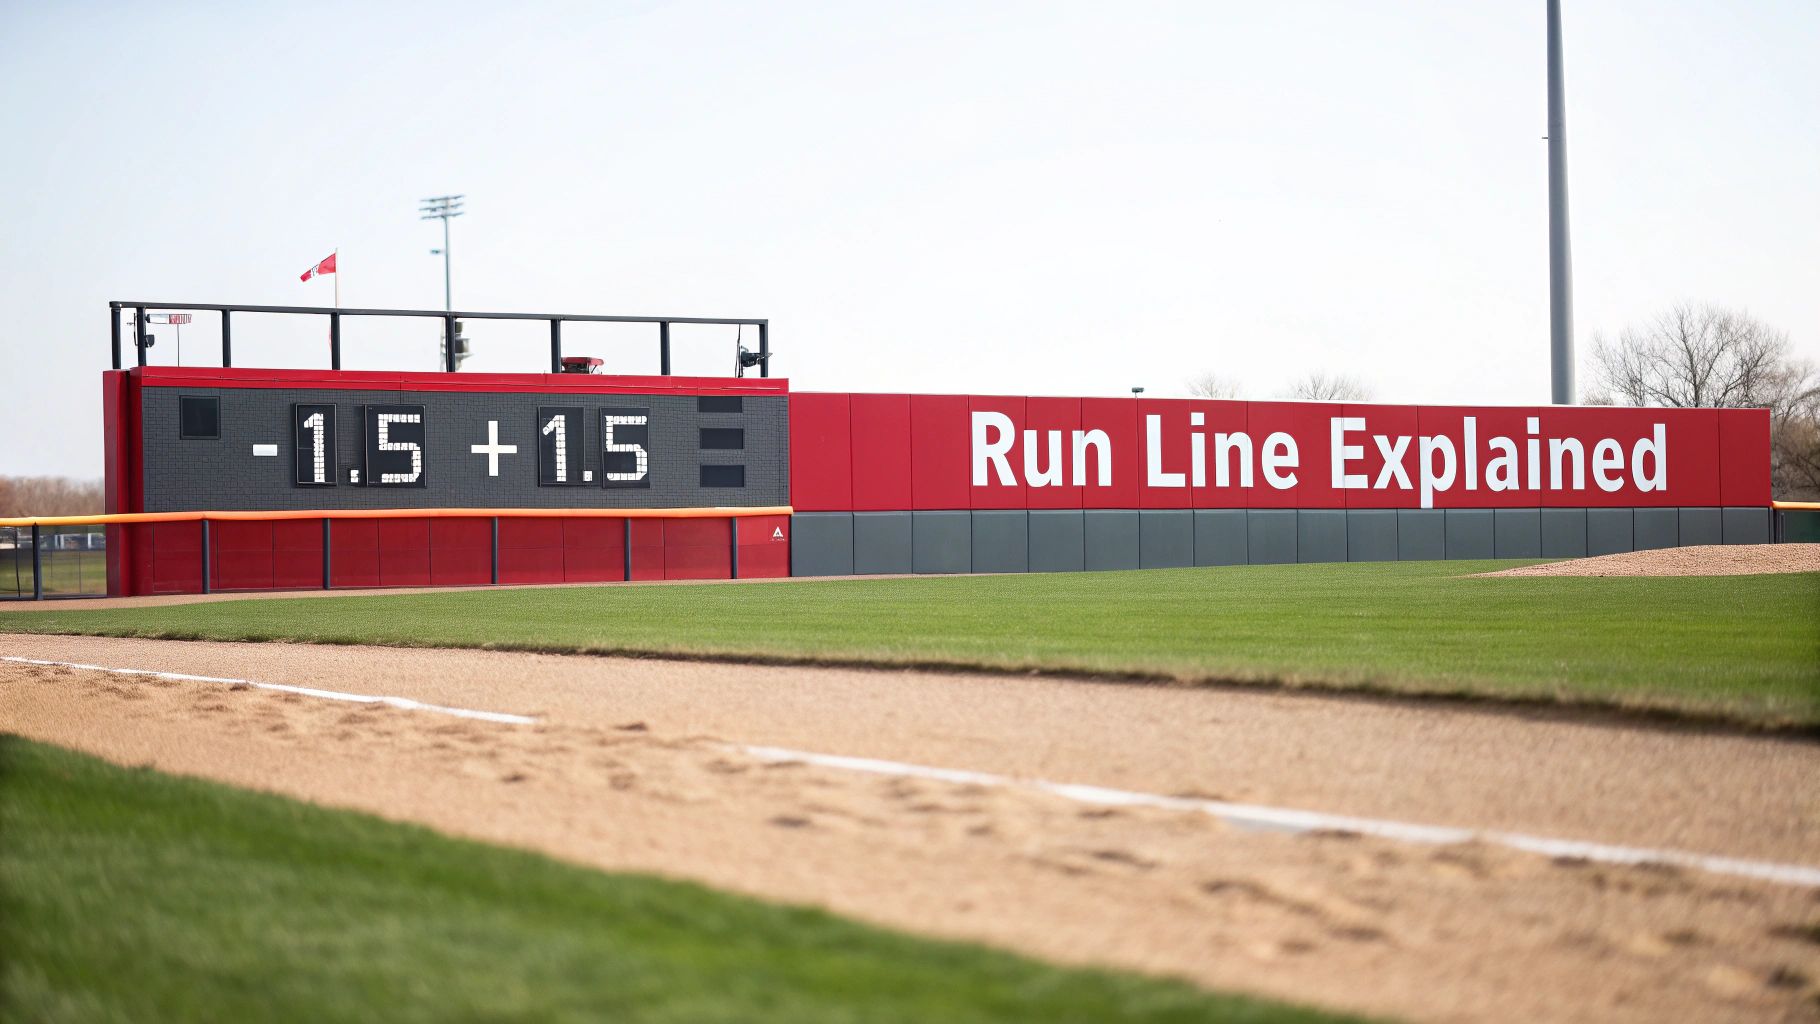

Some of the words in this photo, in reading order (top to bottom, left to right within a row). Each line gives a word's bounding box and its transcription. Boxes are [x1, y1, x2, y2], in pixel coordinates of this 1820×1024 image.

[971, 411, 1112, 488] Run
[1146, 412, 1300, 490] Line
[1330, 416, 1667, 509] Explained
